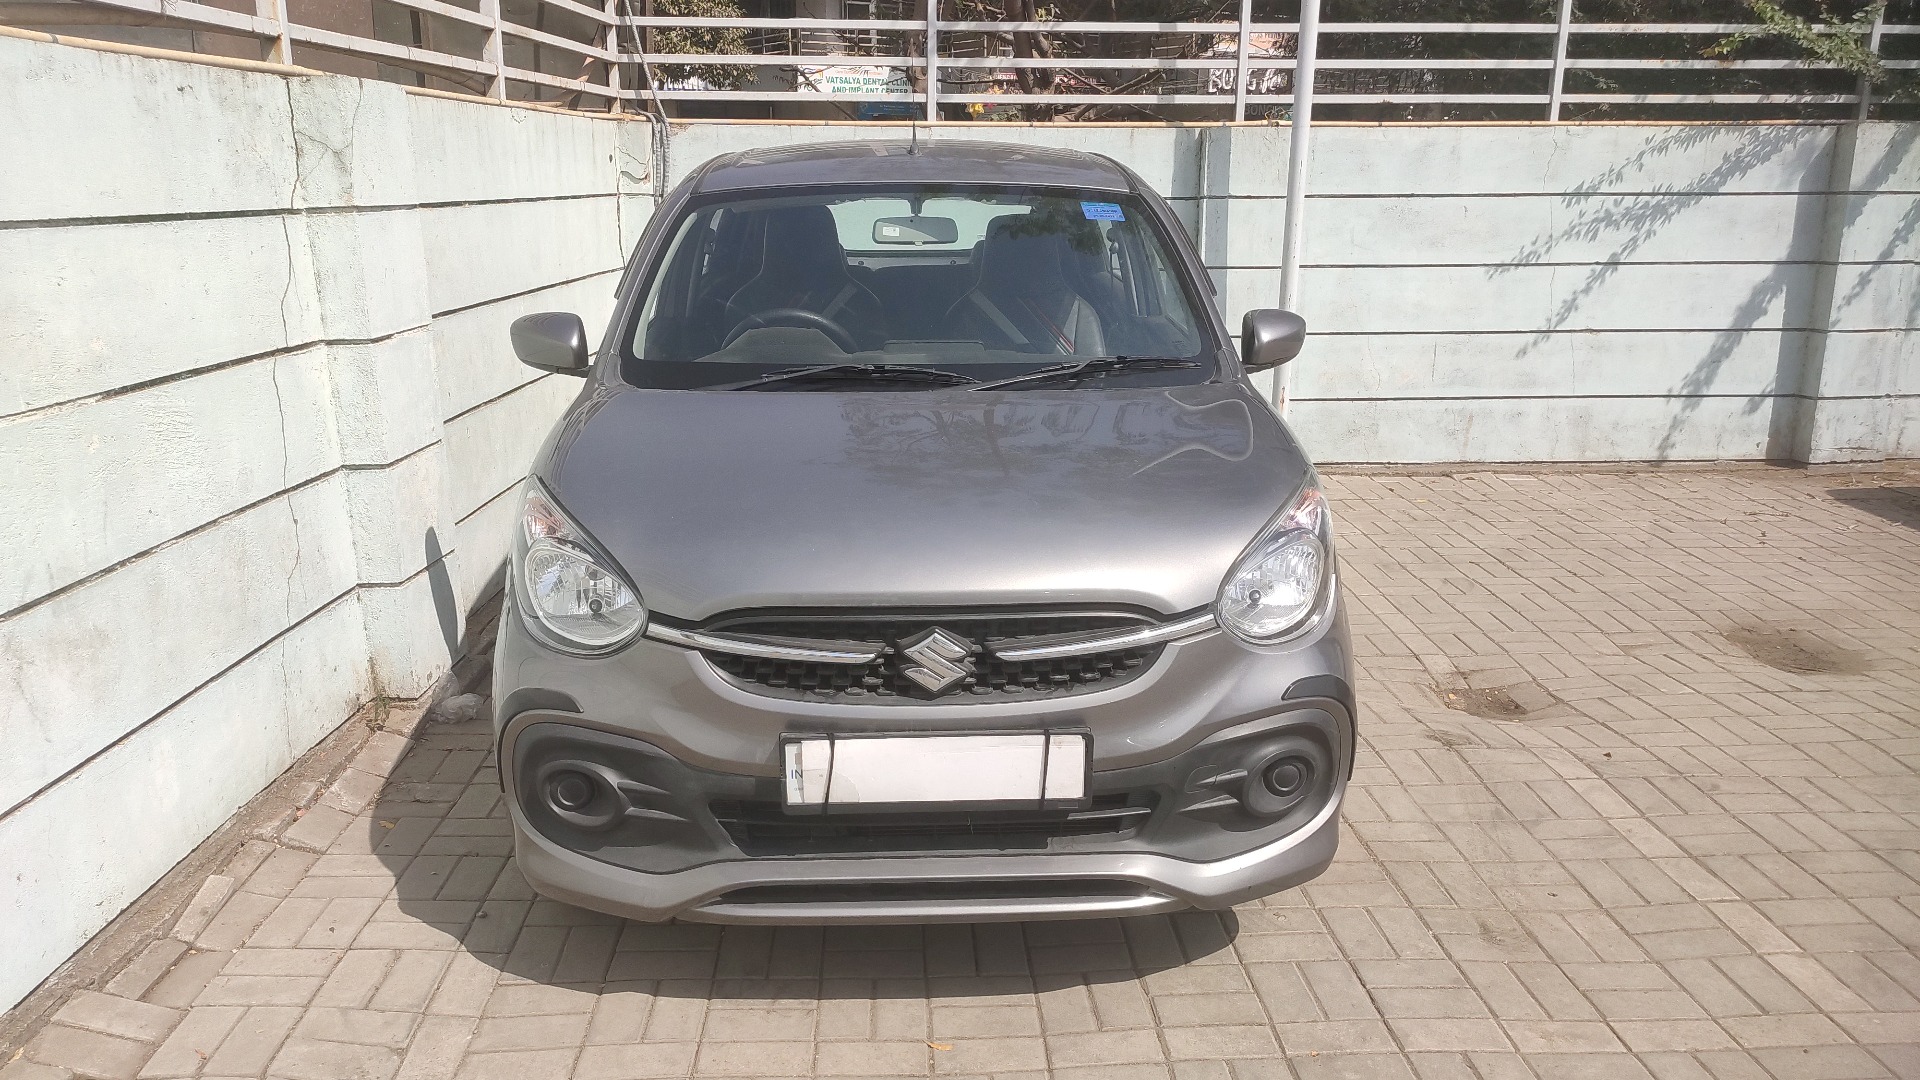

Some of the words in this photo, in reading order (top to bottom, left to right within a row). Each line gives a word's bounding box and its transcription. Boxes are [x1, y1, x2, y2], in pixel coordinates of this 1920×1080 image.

[825, 76, 861, 85] VATSALYA
[863, 76, 889, 86] DENTAL
[791, 769, 803, 780] IN
